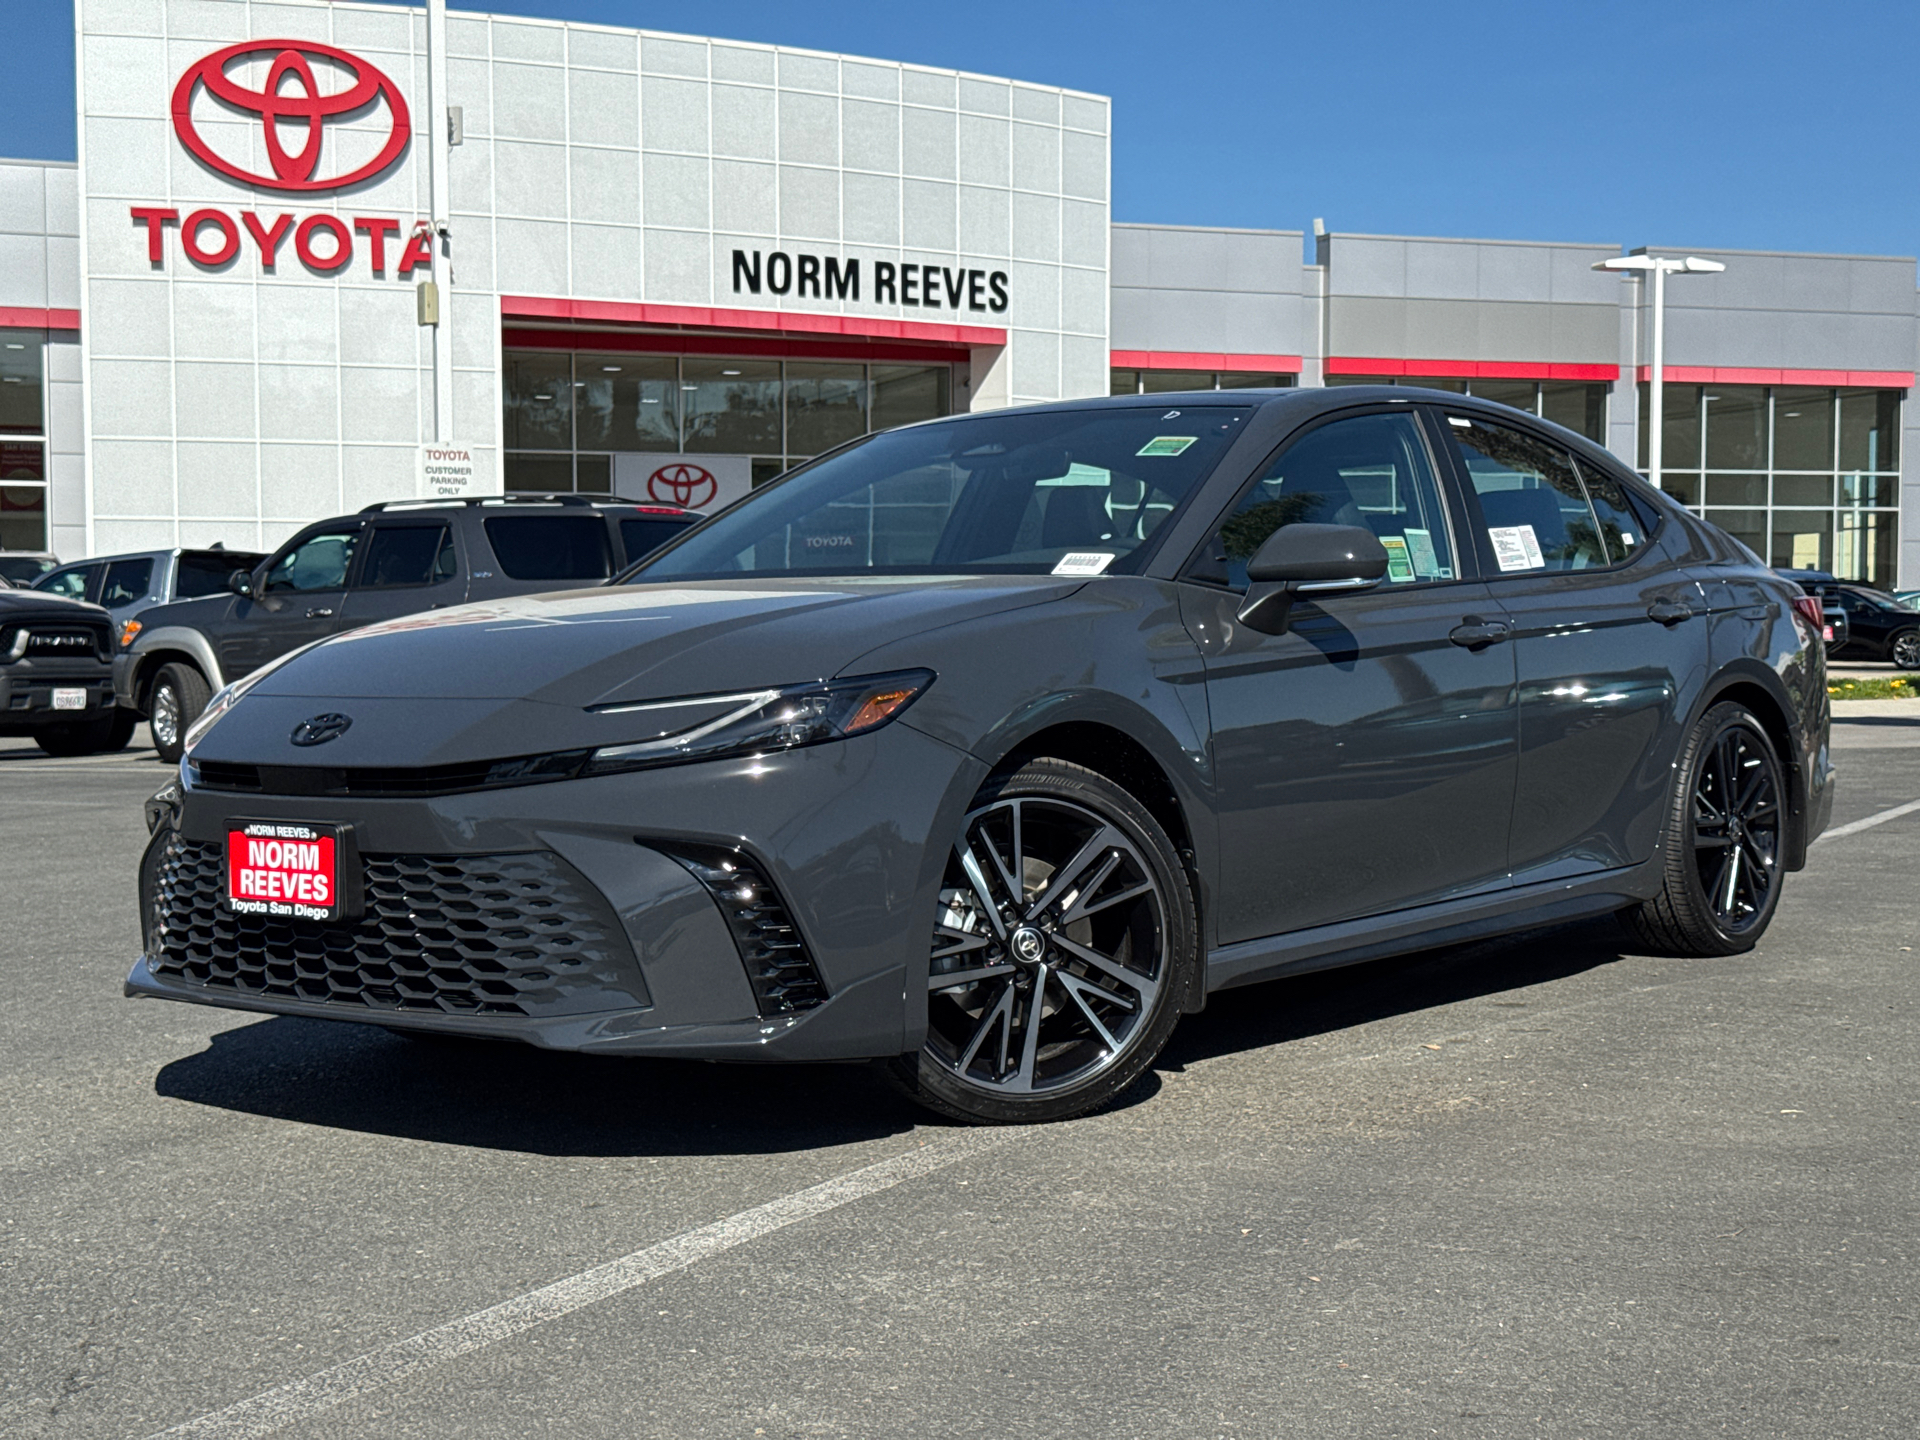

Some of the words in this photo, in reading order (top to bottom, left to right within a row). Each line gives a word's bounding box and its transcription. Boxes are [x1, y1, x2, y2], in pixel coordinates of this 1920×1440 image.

[131, 207, 432, 272] TOYOTA
[732, 249, 860, 301] NORM
[874, 260, 1009, 313] REEVES
[426, 450, 470, 461] TOYOTA
[425, 466, 472, 475] CUSTOMER
[430, 476, 467, 485] PARKING
[438, 487, 460, 495] ONLY
[806, 536, 853, 547] TOYOTA
[249, 824, 276, 836] NORM
[276, 826, 310, 839] REEVES
[248, 840, 320, 871] NORM
[240, 868, 329, 902] REEVES
[230, 898, 267, 913] Toyota
[269, 901, 292, 914] San
[294, 903, 329, 920] Diego
